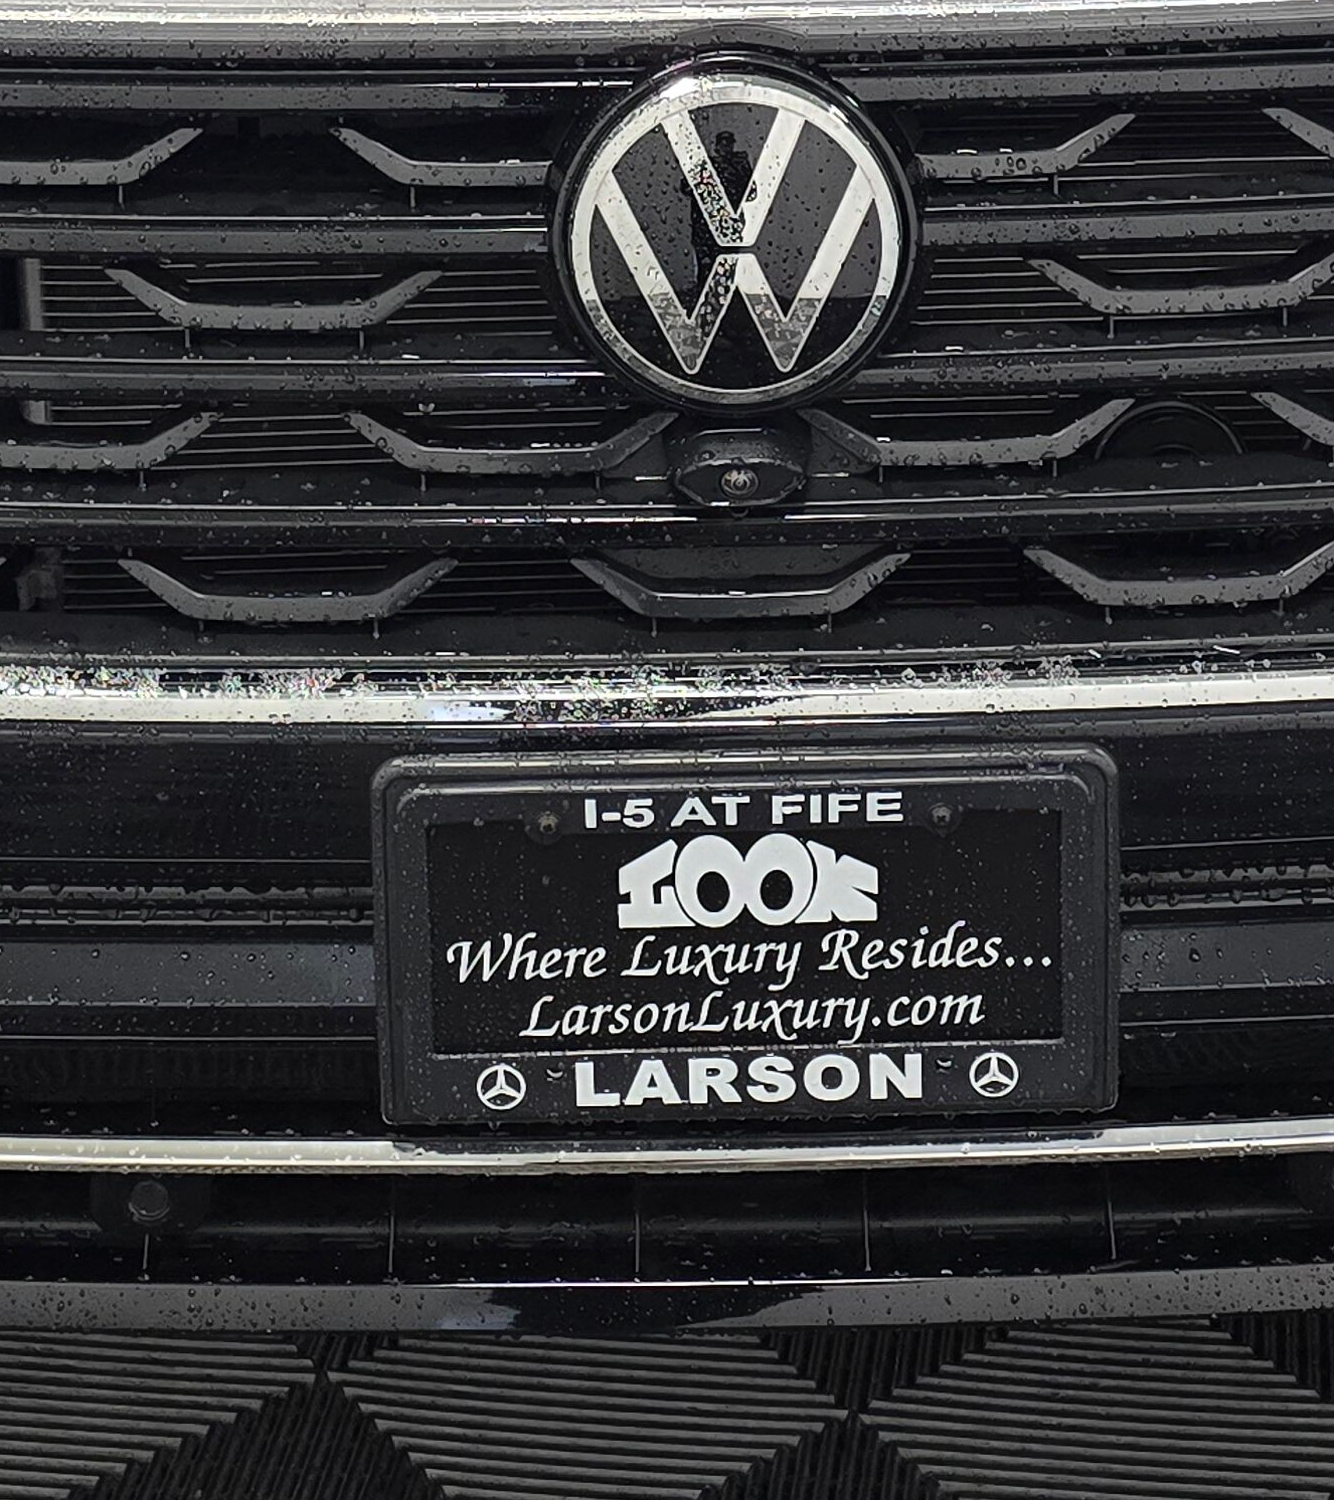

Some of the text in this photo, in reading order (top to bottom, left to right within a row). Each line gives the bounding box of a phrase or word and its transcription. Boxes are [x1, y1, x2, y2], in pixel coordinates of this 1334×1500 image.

[584, 791, 904, 828] I-5 AT FIFE
[618, 833, 879, 929] LOOK
[446, 921, 1053, 991] Where Luxury Resides...
[518, 988, 986, 1042] LarsonLuxury.com
[574, 1052, 923, 1108] LARSON
